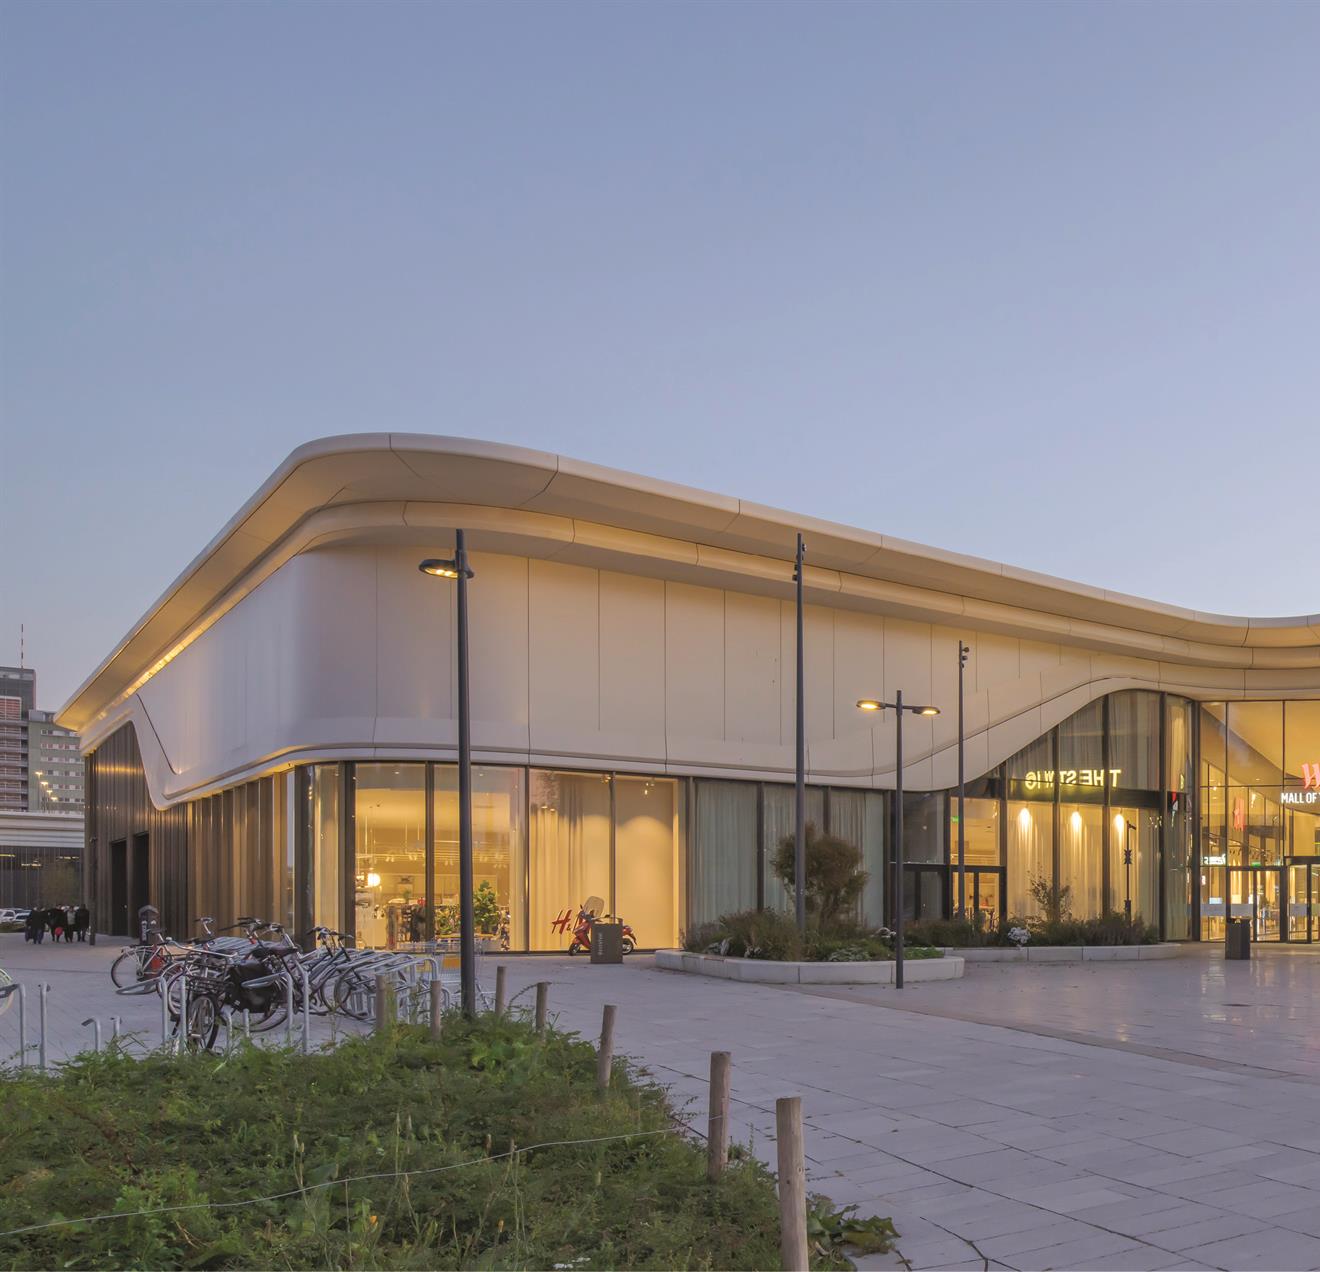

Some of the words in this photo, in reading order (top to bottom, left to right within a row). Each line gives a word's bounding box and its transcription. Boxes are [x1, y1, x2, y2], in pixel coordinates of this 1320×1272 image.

[1280, 792, 1304, 804] MALL
[1306, 792, 1317, 804] OF
[551, 909, 580, 934] H&
